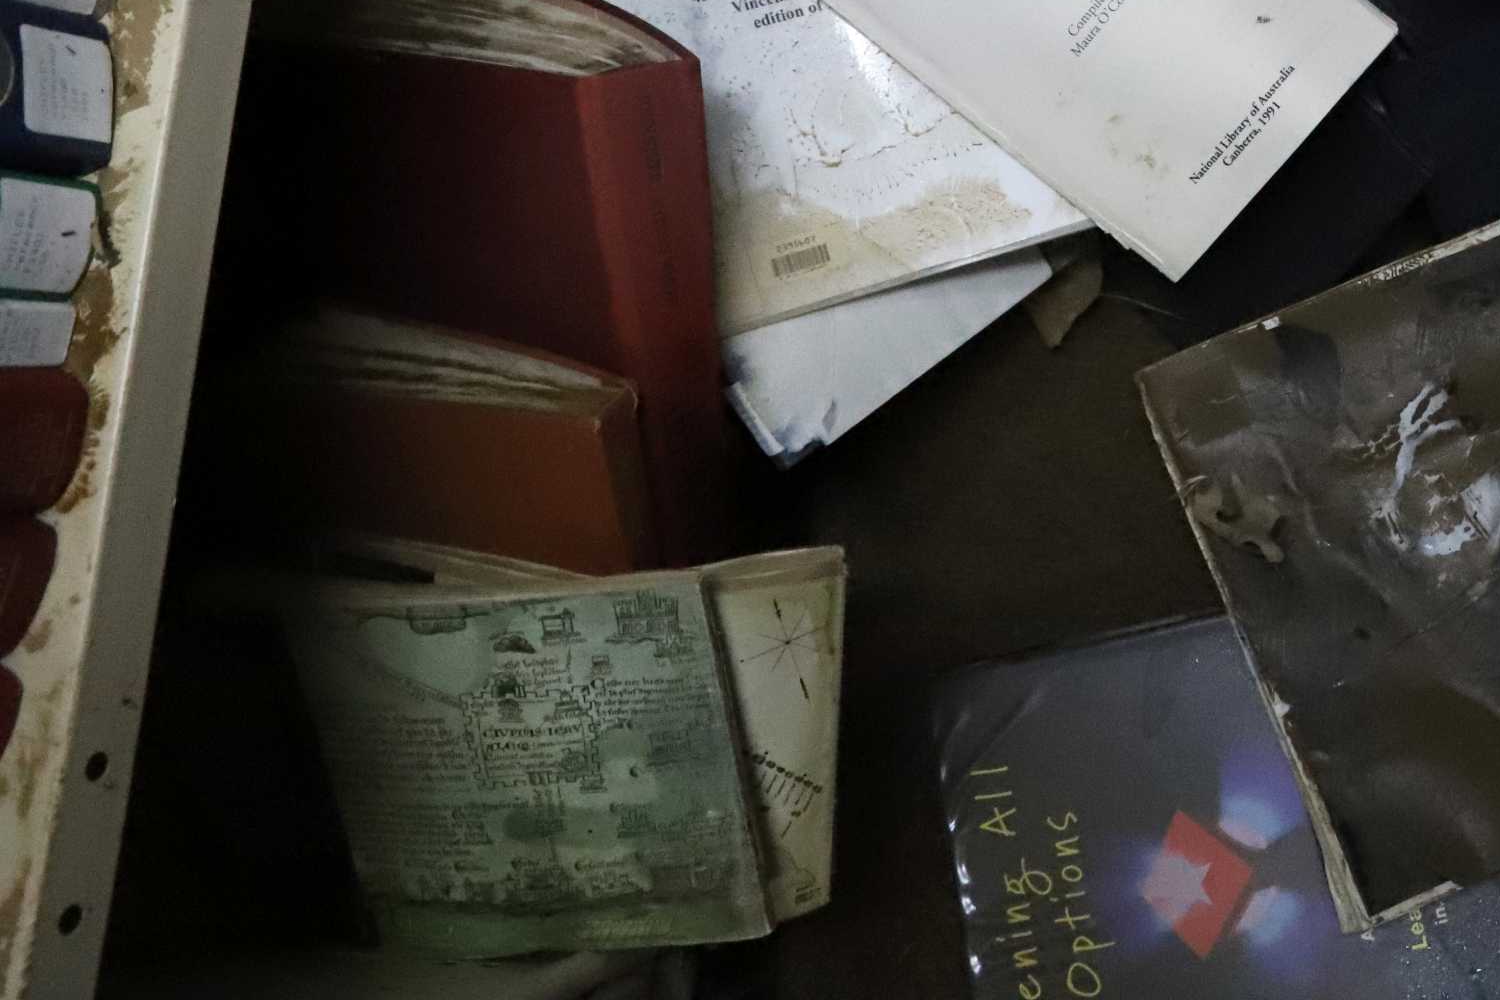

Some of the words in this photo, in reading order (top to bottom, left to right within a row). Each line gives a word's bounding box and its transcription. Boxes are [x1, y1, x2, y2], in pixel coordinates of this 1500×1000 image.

[754, 9, 803, 28] edition
[808, 0, 821, 13] of
[1069, 23, 1101, 57] Maura
[1189, 147, 1224, 184] National
[1220, 116, 1252, 149] Library
[1250, 103, 1260, 117] of
[1258, 65, 1295, 105] Australia
[1222, 127, 1262, 166] Canberra,
[1258, 101, 1281, 126] 1991
[969, 767, 1016, 835] All
[1047, 812, 1116, 994] Options
[1409, 904, 1430, 949] Lea
